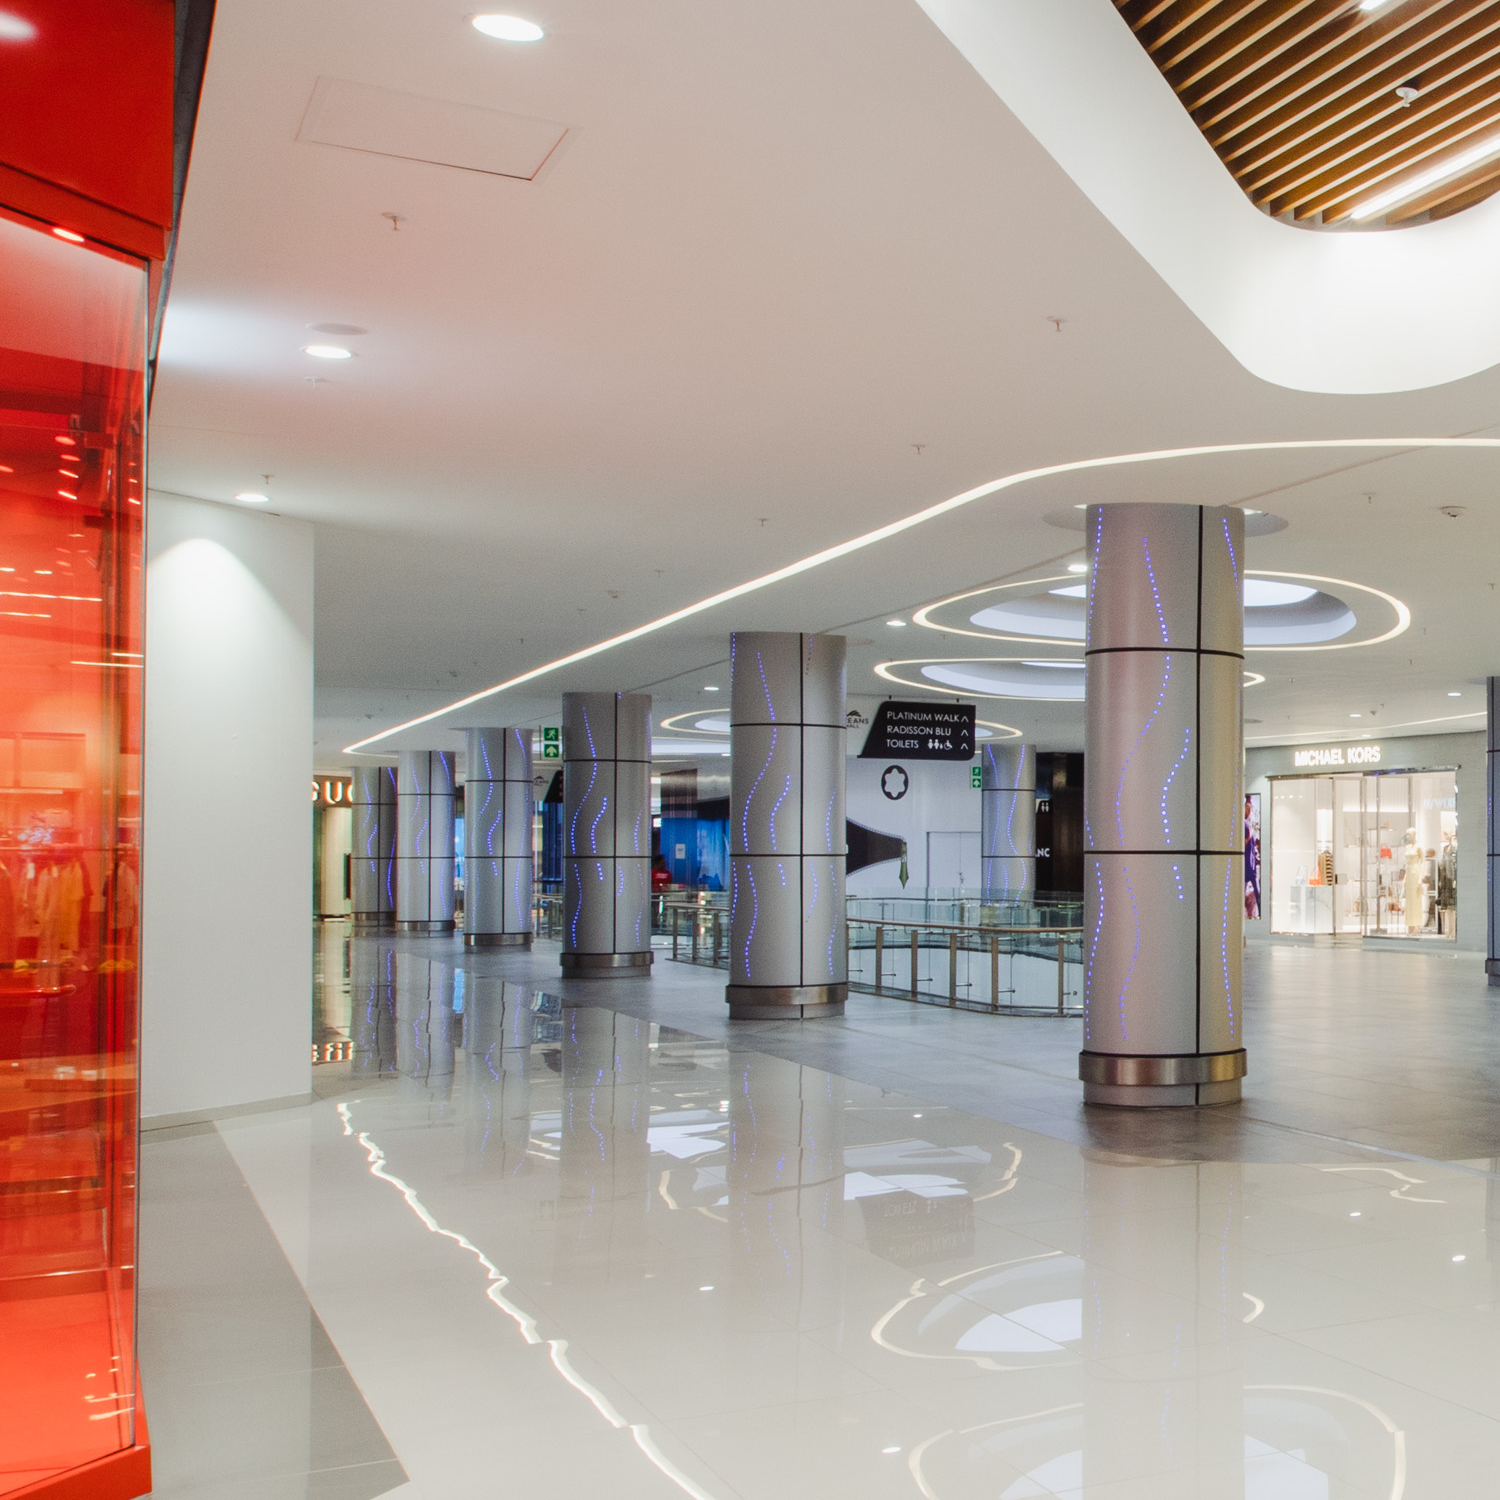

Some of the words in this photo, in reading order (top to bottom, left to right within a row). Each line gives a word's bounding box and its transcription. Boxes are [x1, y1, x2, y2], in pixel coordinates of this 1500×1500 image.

[847, 717, 869, 725] EANS
[886, 711, 932, 721] PLATINUM
[934, 713, 960, 722] WALK
[886, 725, 933, 735] RADISSON
[935, 727, 952, 736] BLU
[886, 739, 919, 749] TOILETS
[1294, 748, 1345, 767] MICHAEL
[1347, 746, 1381, 764] KORS
